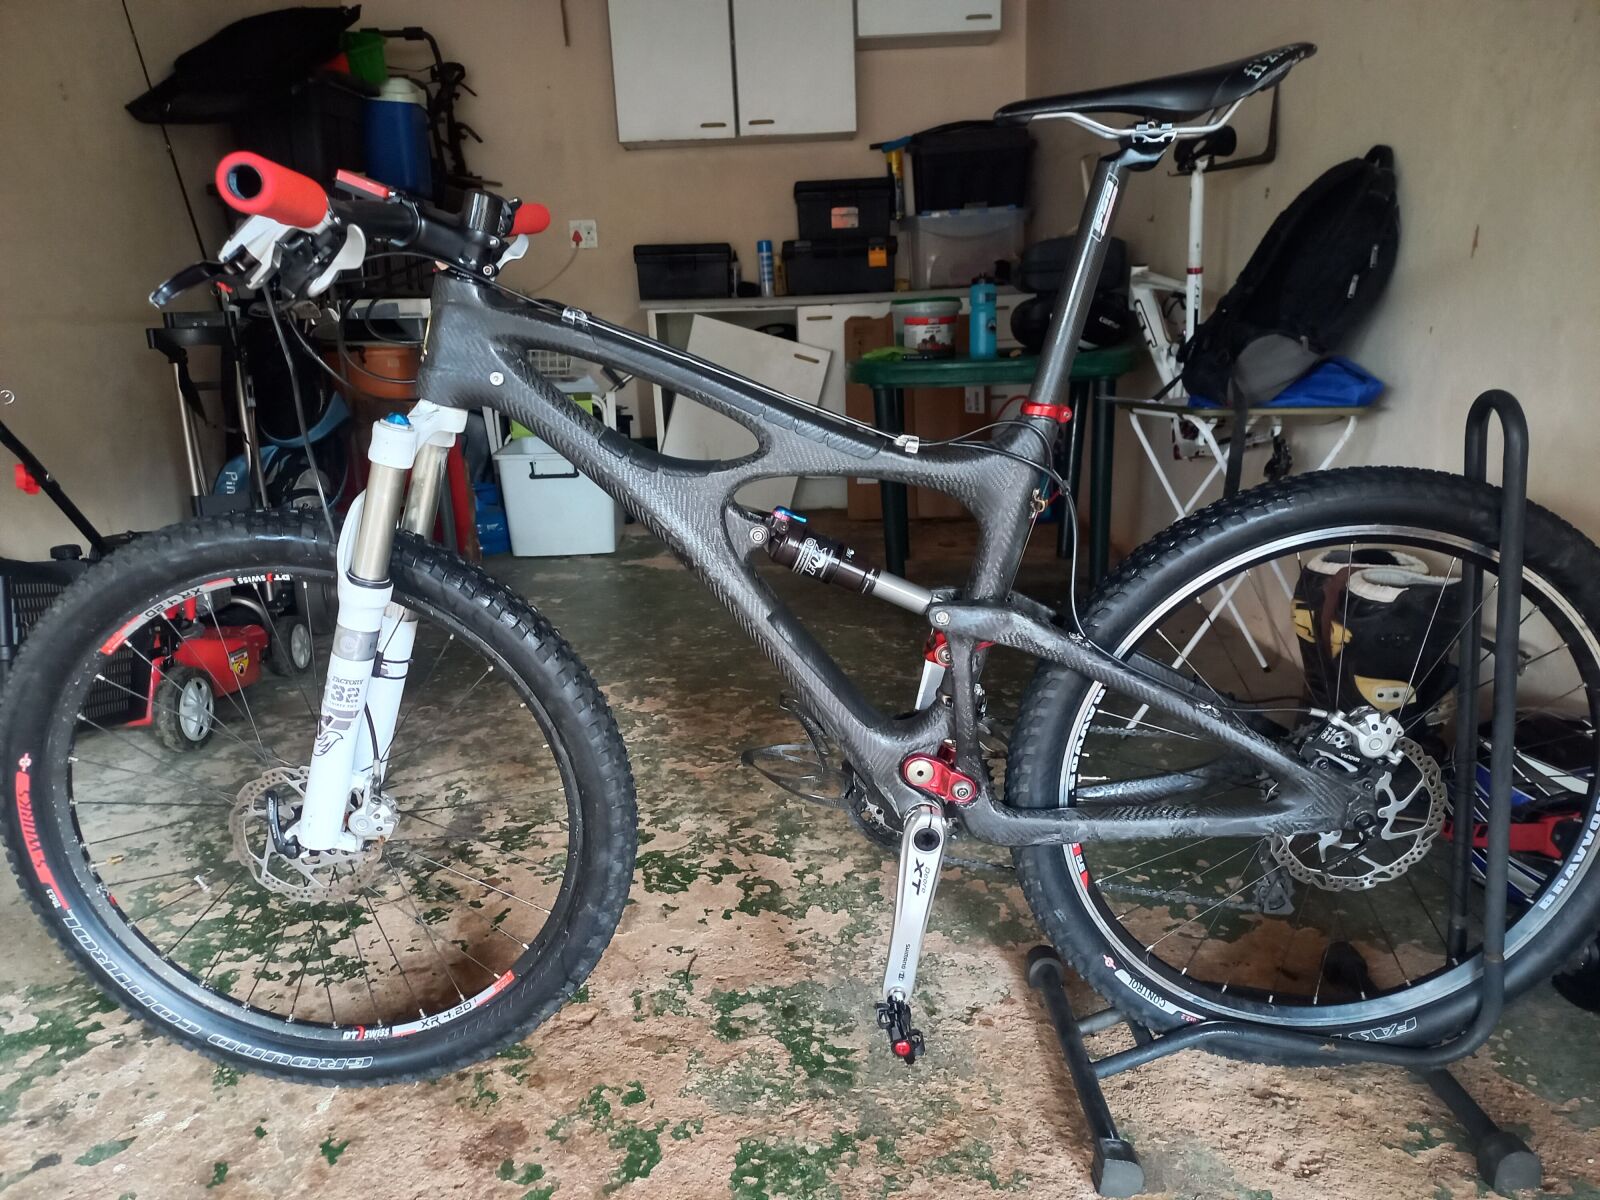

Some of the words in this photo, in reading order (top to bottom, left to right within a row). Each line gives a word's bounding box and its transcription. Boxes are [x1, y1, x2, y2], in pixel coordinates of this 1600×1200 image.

[237, 574, 267, 585] SWISS
[274, 573, 291, 581] DT
[179, 587, 204, 600] XR
[330, 684, 361, 703] 32
[331, 676, 364, 686] FACTORY
[1068, 688, 1107, 791] RAVVOS
[911, 857, 925, 896] XT
[921, 866, 931, 894] Deore
[901, 943, 911, 970] SHIMANO
[62, 909, 202, 1035] CONTROL
[1128, 978, 1167, 1009] CONTROL
[420, 1016, 440, 1029] XR
[443, 1002, 472, 1020] 4.20
[1330, 1016, 1417, 1041] FAS
[342, 1031, 359, 1041] DT
[363, 1027, 390, 1040] SWISS
[207, 1033, 374, 1070] GROUND
